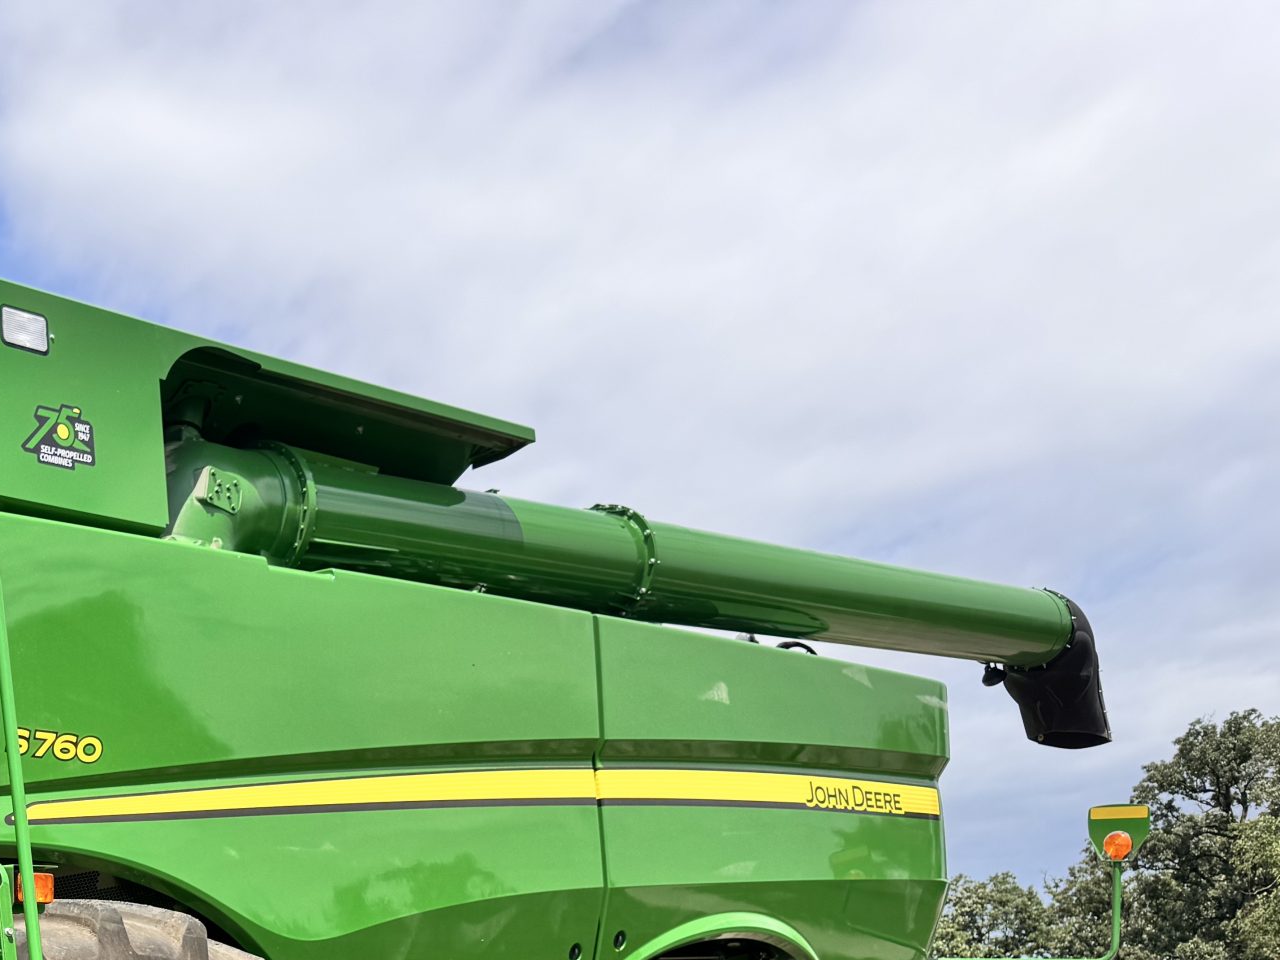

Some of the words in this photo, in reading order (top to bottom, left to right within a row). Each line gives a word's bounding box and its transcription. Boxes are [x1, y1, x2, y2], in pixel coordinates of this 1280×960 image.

[75, 423, 90, 433] SINCE
[78, 431, 90, 442] 1947
[40, 445, 92, 463] SELF-PROPELLED
[40, 453, 73, 467] COMBINES
[806, 781, 849, 806] JOHN
[852, 785, 903, 811] DEERE
